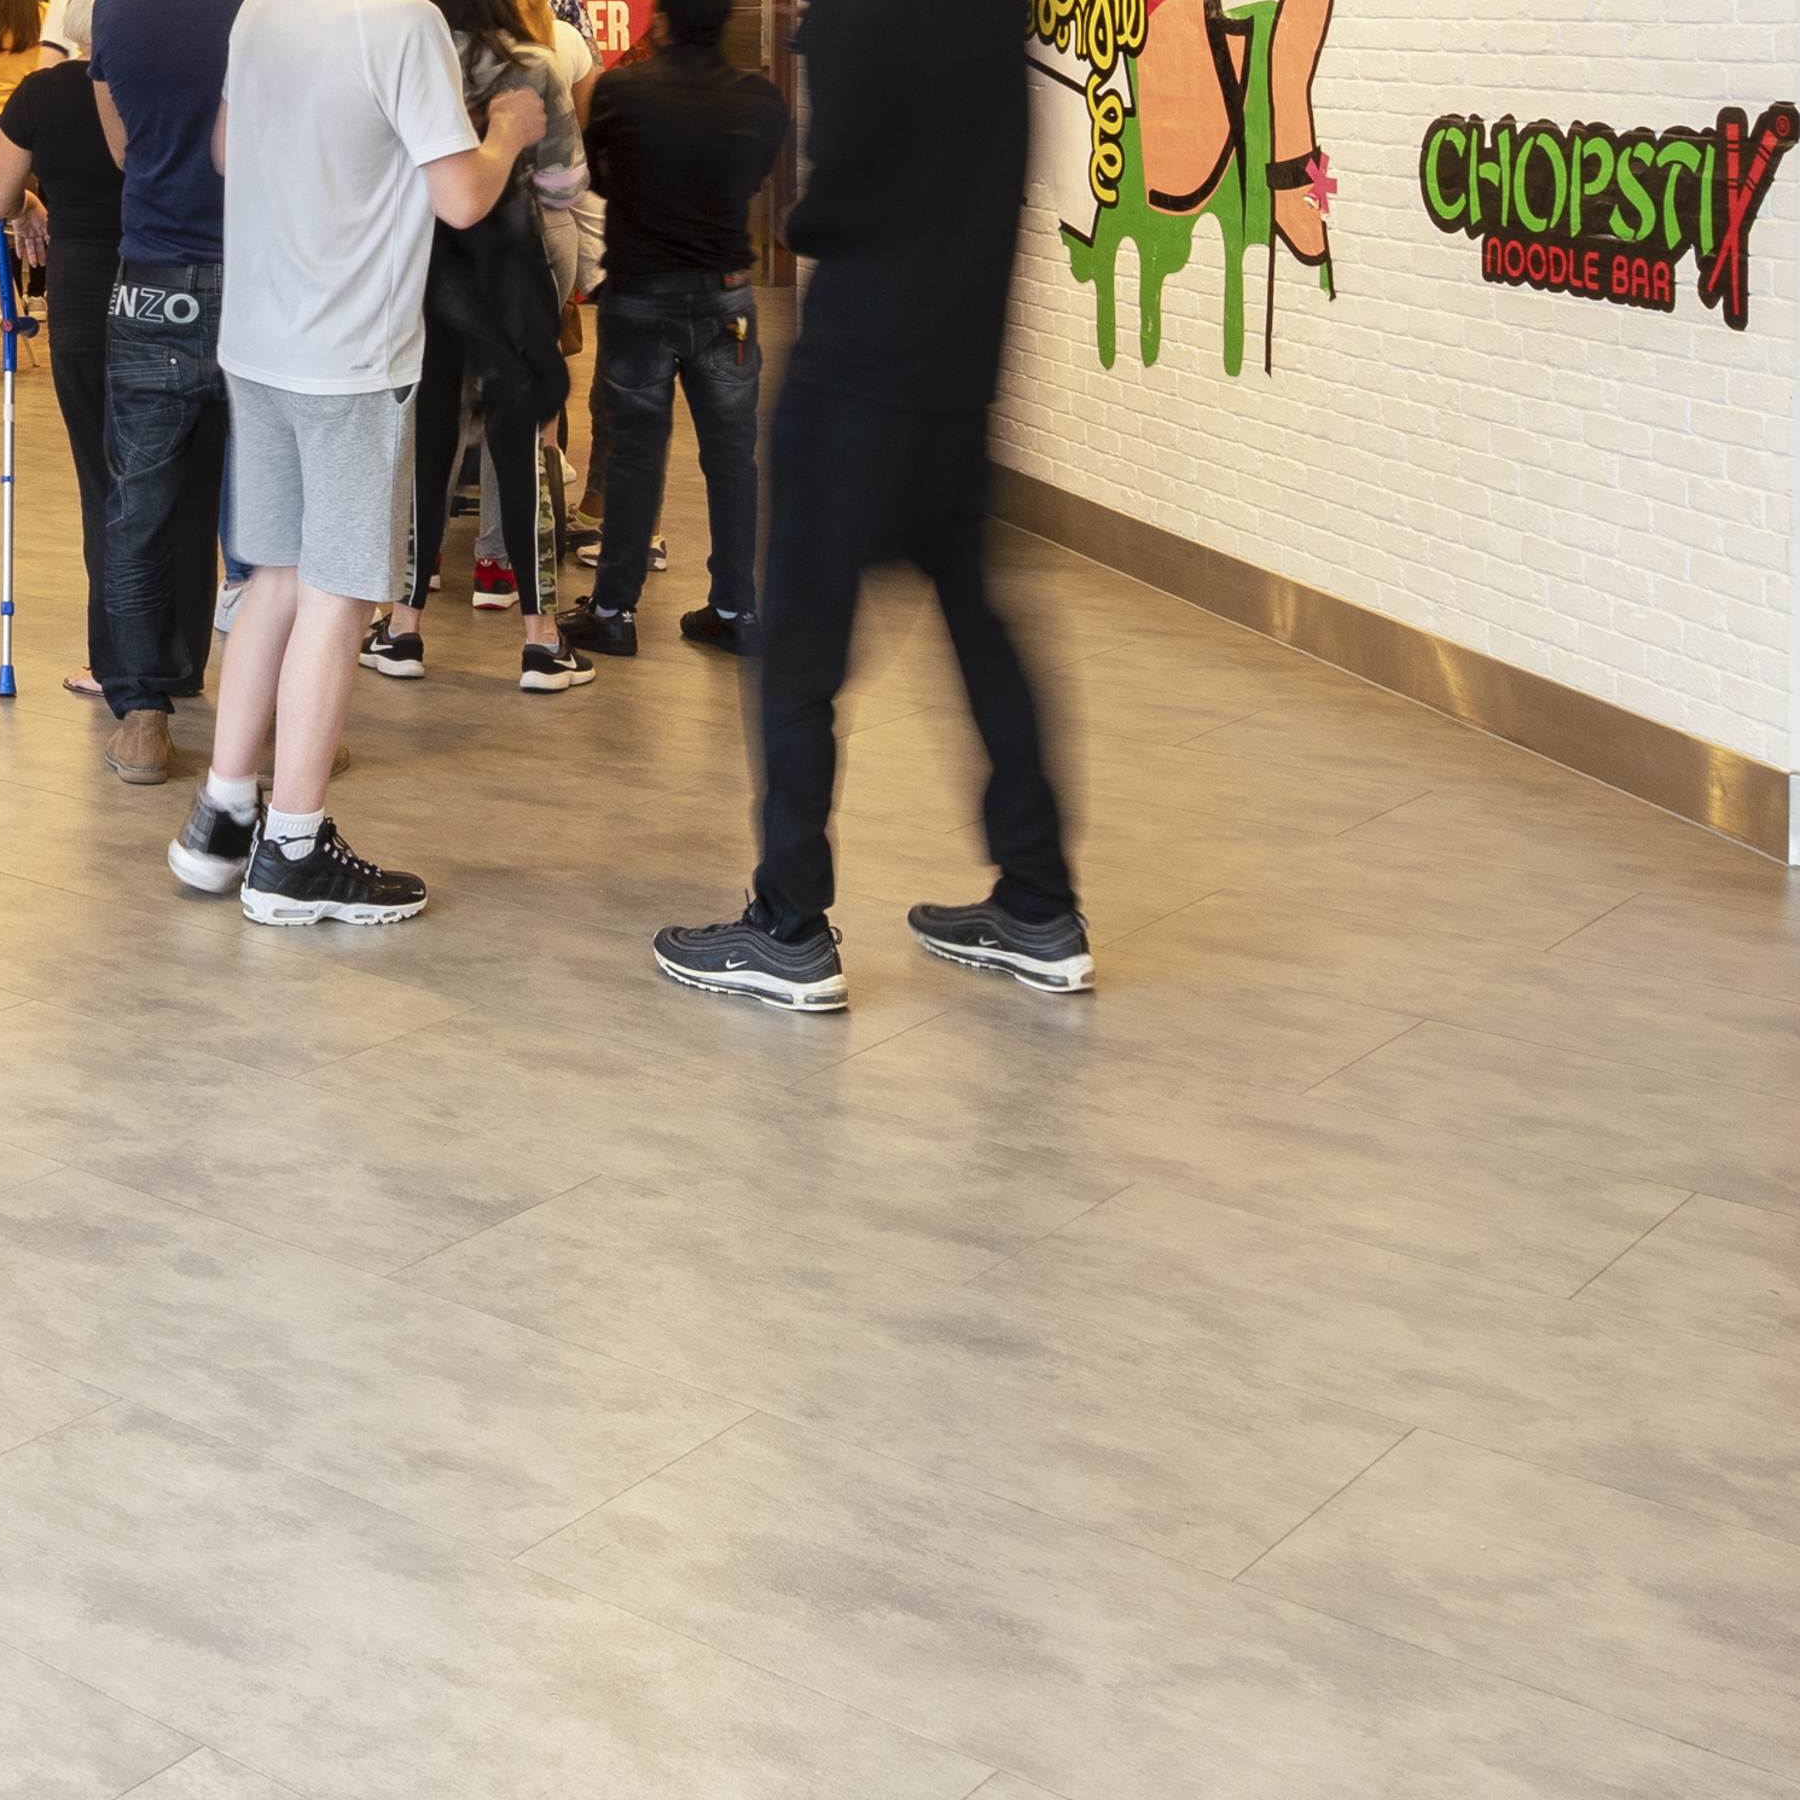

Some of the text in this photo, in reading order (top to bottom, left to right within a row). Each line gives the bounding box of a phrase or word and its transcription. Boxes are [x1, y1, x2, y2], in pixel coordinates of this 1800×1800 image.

[1425, 122, 1779, 316] CHOPSTIX
[1485, 236, 1671, 303] NOODLE BAR
